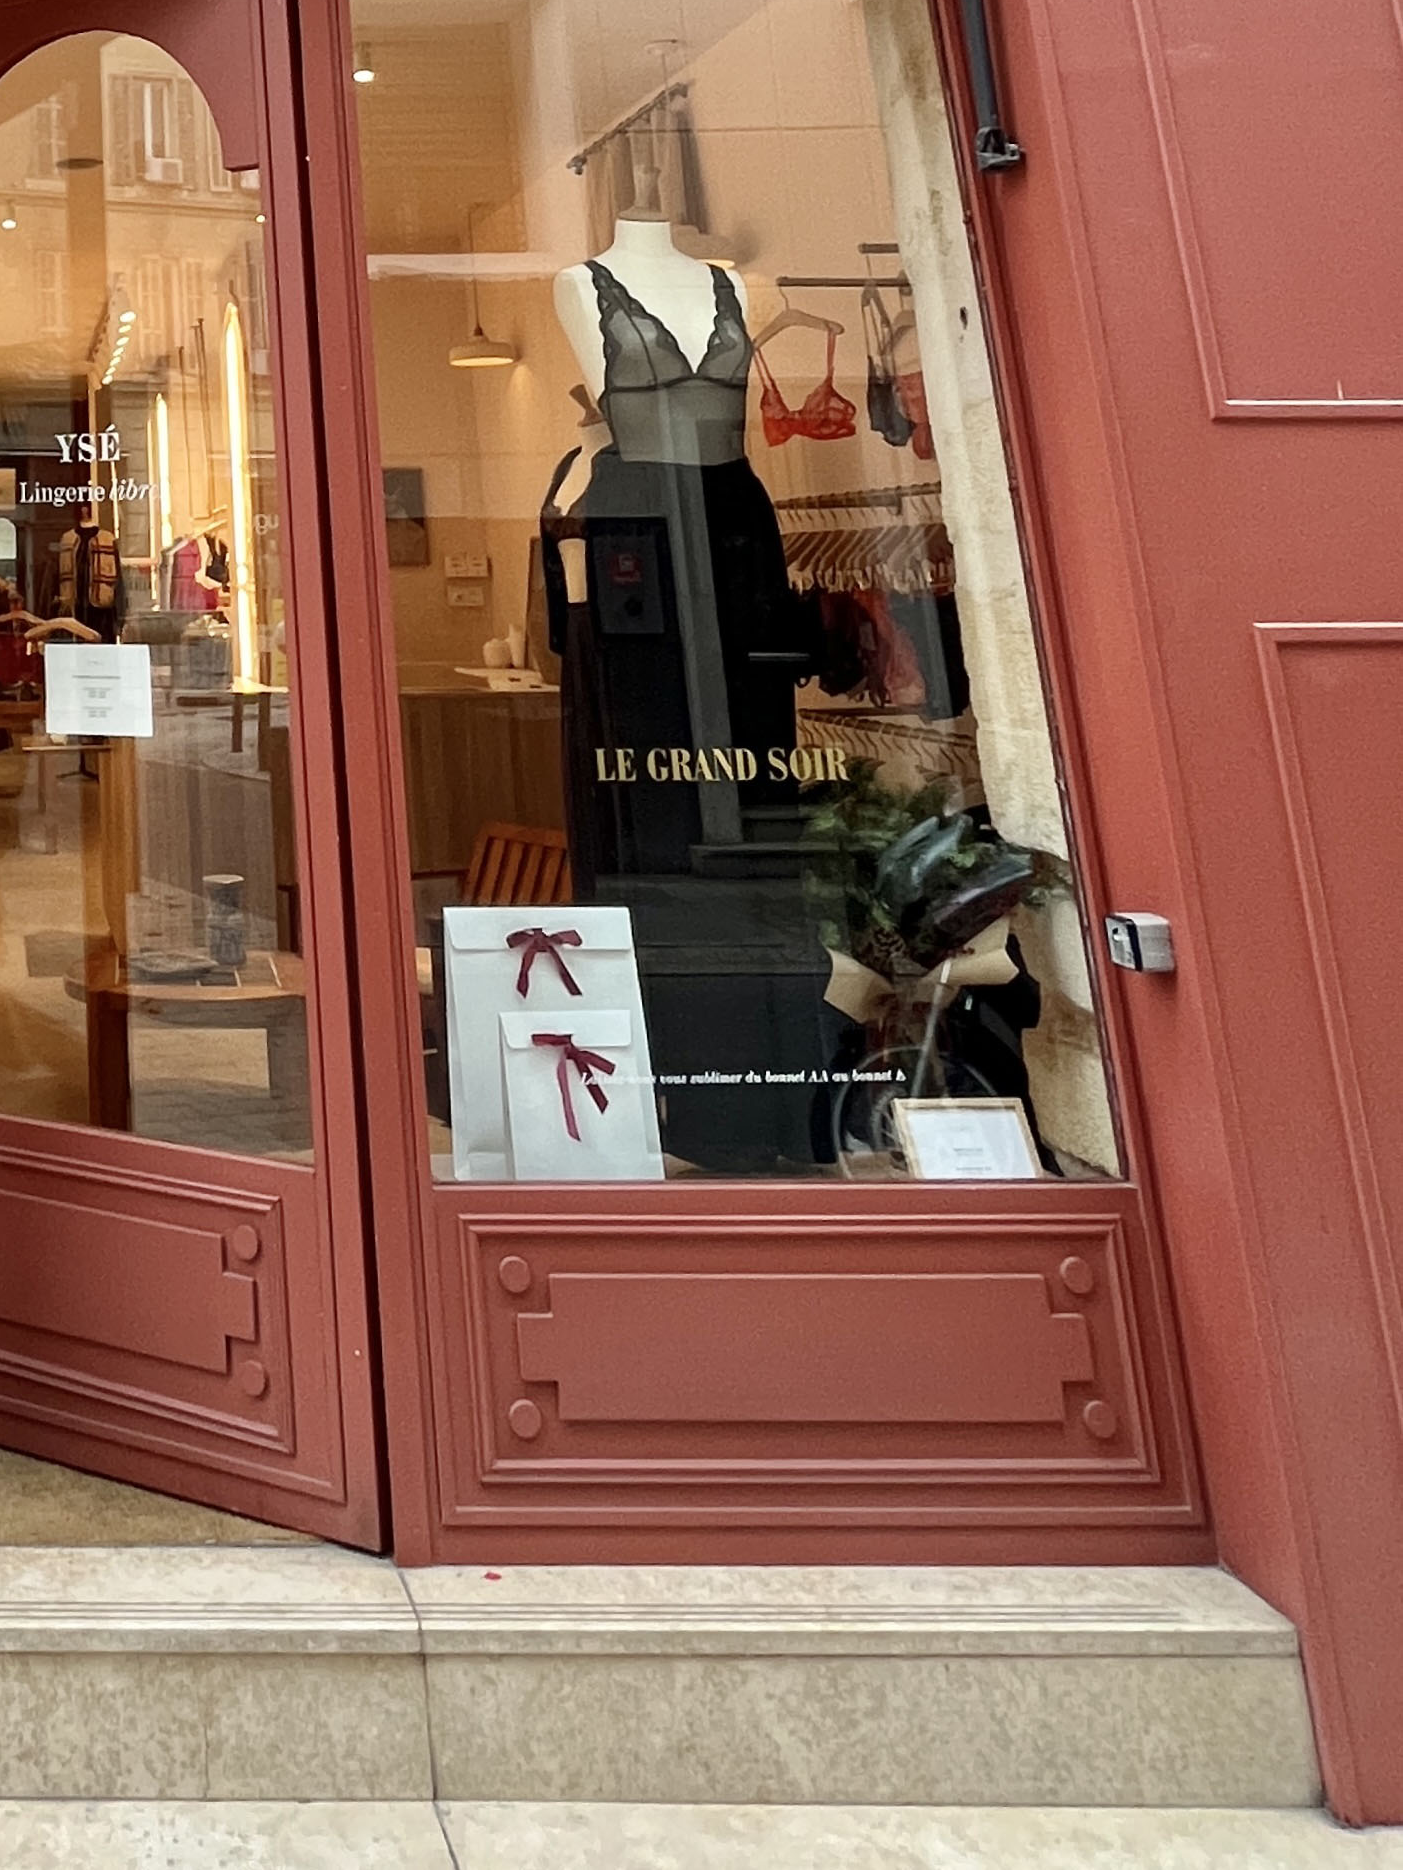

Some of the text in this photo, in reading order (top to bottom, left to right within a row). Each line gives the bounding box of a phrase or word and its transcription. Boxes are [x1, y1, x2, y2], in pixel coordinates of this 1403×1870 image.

[54, 423, 121, 463] YSÉ
[19, 481, 105, 507] Lingerie
[594, 746, 851, 782] LE GRAND SOIR
